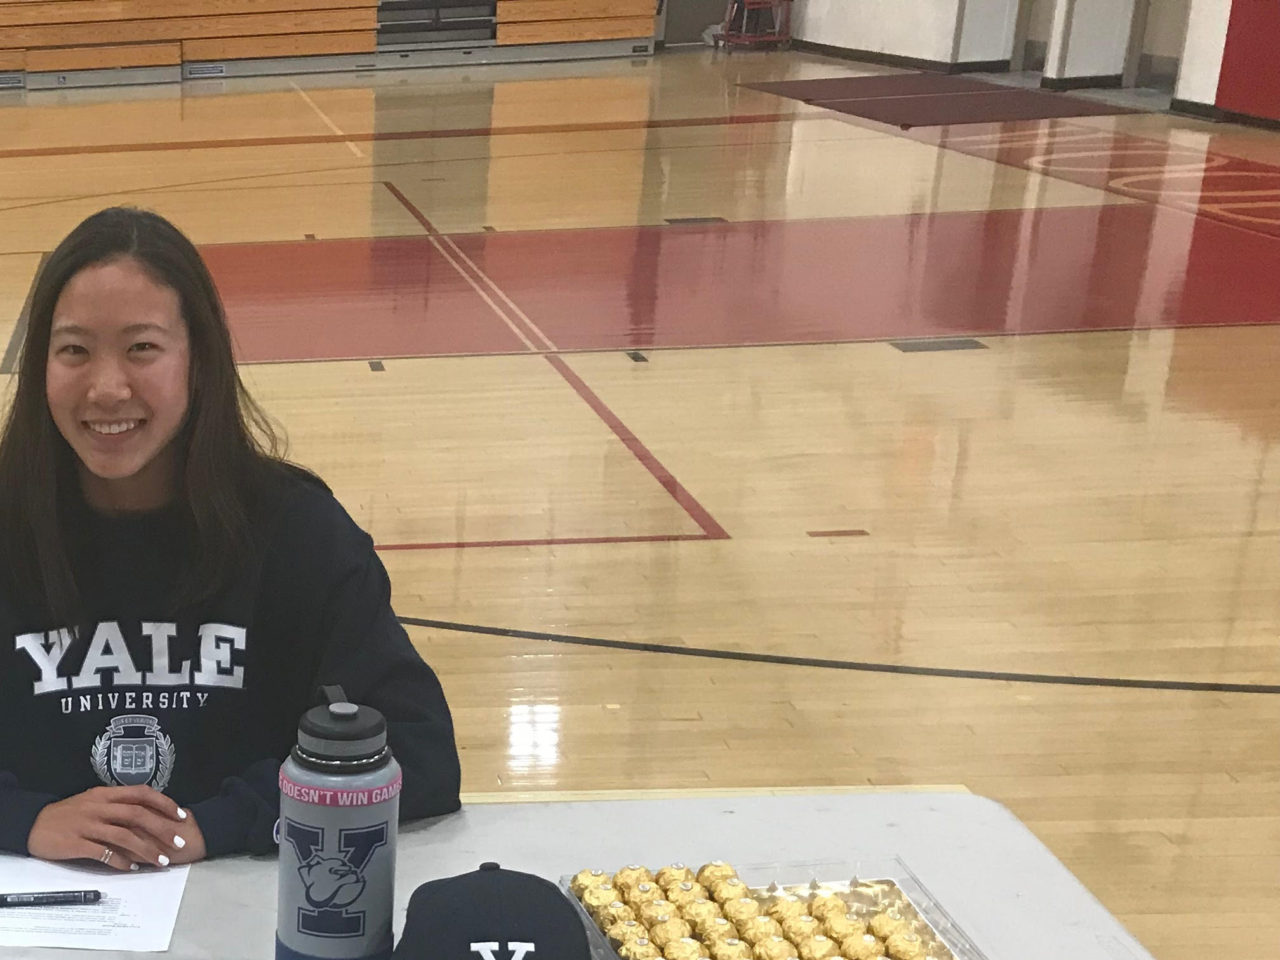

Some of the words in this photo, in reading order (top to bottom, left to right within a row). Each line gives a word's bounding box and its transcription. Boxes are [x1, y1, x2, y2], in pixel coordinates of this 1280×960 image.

[15, 621, 247, 695] YALE
[60, 691, 209, 714] UNIVERSITY
[282, 779, 333, 805] DOESN'T
[337, 791, 368, 806] WIN
